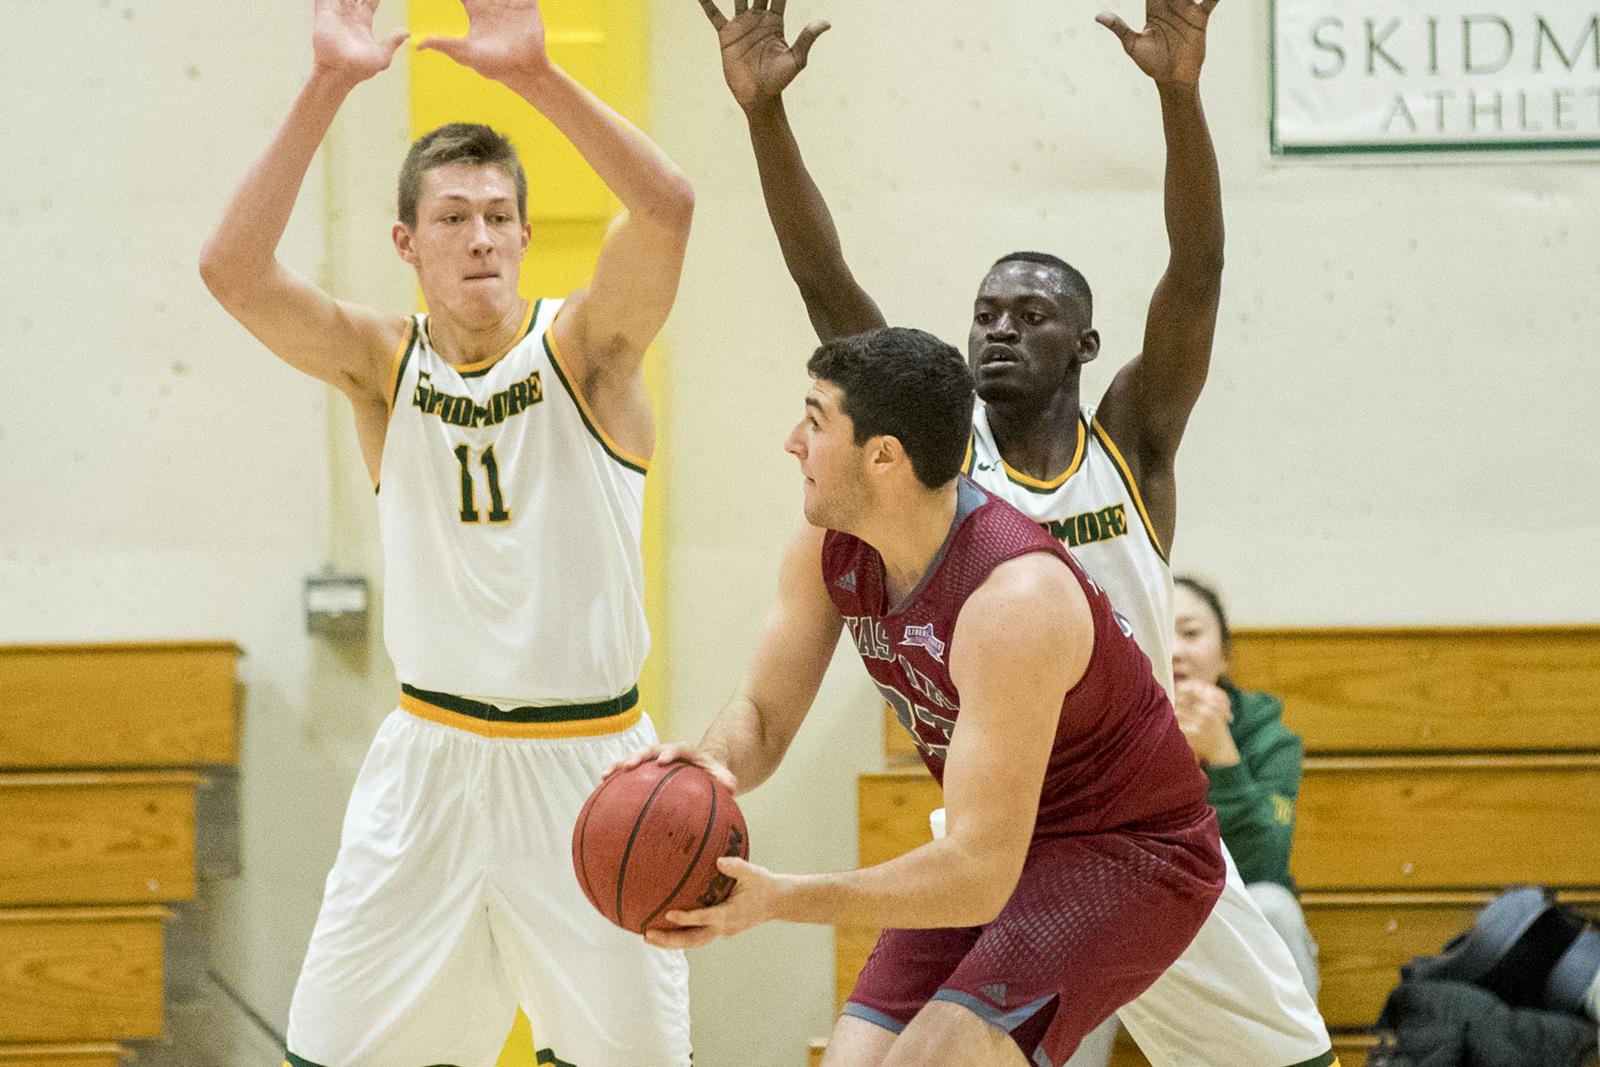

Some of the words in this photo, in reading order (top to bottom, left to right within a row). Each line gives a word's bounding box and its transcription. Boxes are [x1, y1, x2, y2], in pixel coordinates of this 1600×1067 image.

[1308, 13, 1600, 79] SKIDM
[453, 442, 512, 524] 11
[1039, 503, 1128, 548] MORE
